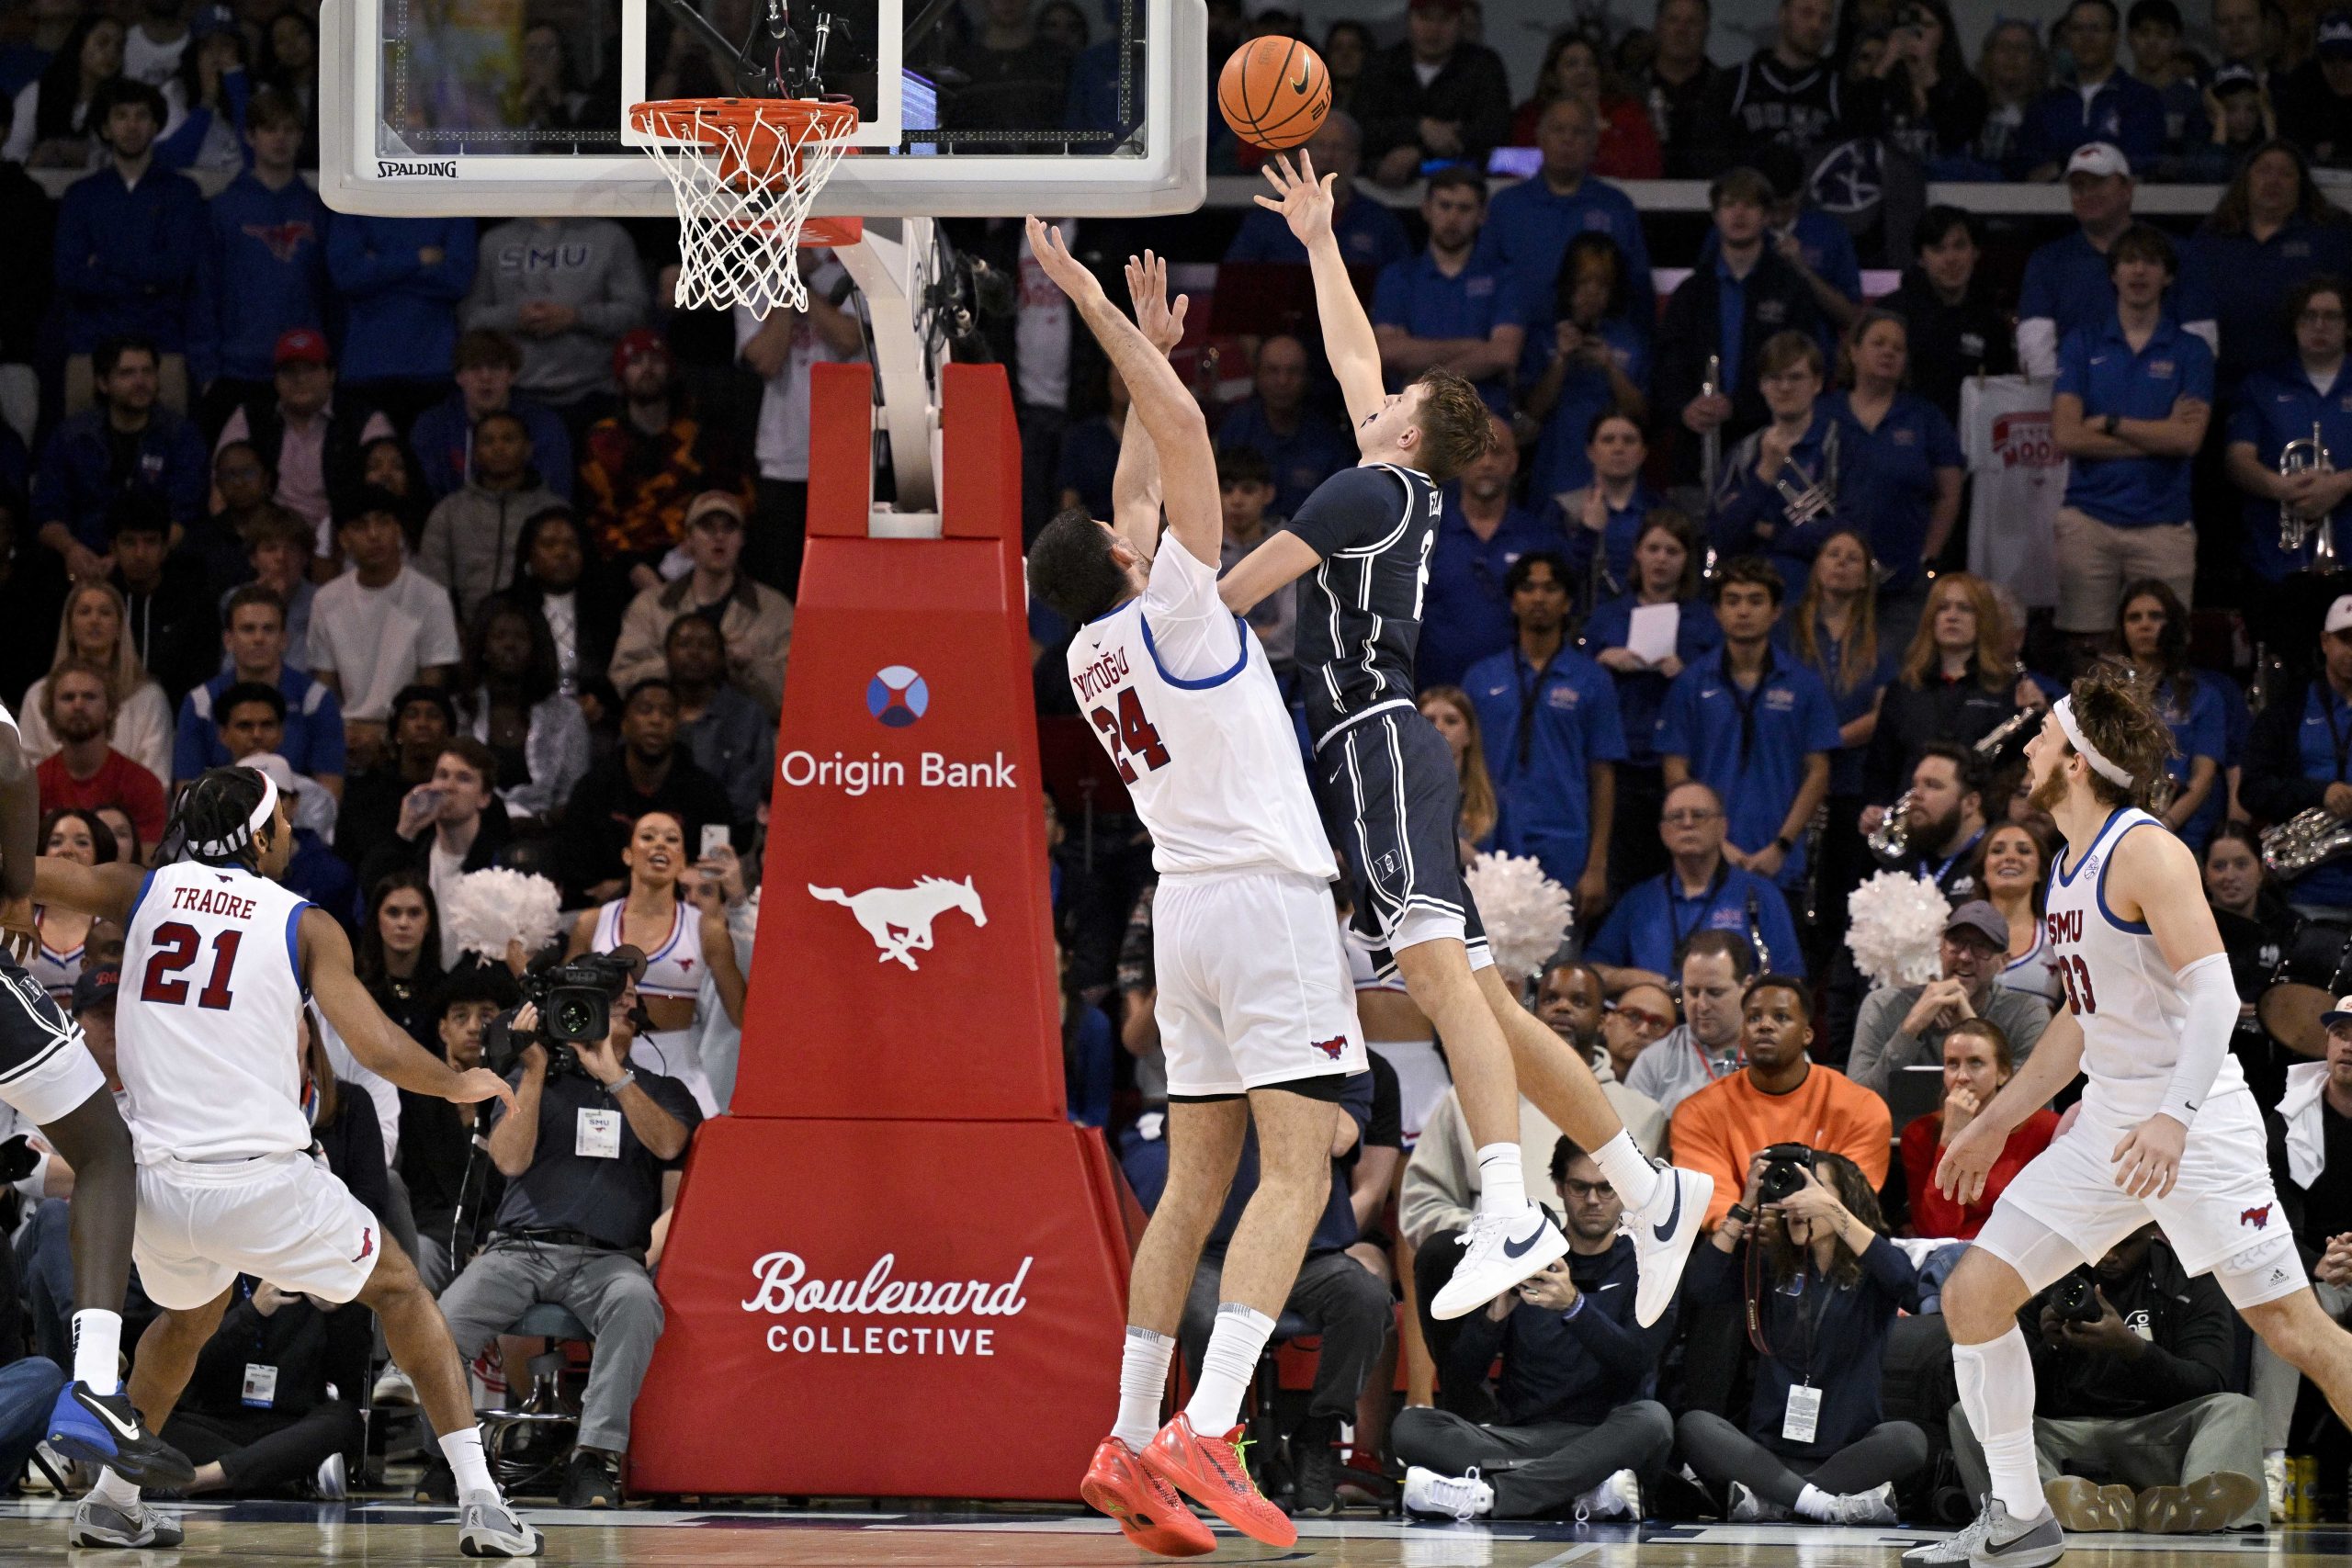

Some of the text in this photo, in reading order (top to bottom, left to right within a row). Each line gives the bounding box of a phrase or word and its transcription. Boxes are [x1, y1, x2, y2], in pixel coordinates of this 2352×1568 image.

[377, 160, 458, 178] SPALDING
[498, 242, 593, 276] SMU
[1090, 685, 1171, 785] 24
[781, 750, 1016, 796] Origin Bank
[172, 887, 257, 919] TRAORE
[2047, 908, 2084, 946] SMU
[140, 920, 243, 1011] 21
[2059, 953, 2097, 1016] 33
[741, 1251, 1034, 1316] Boulevard
[766, 1325, 994, 1356] COLLECTIVE
